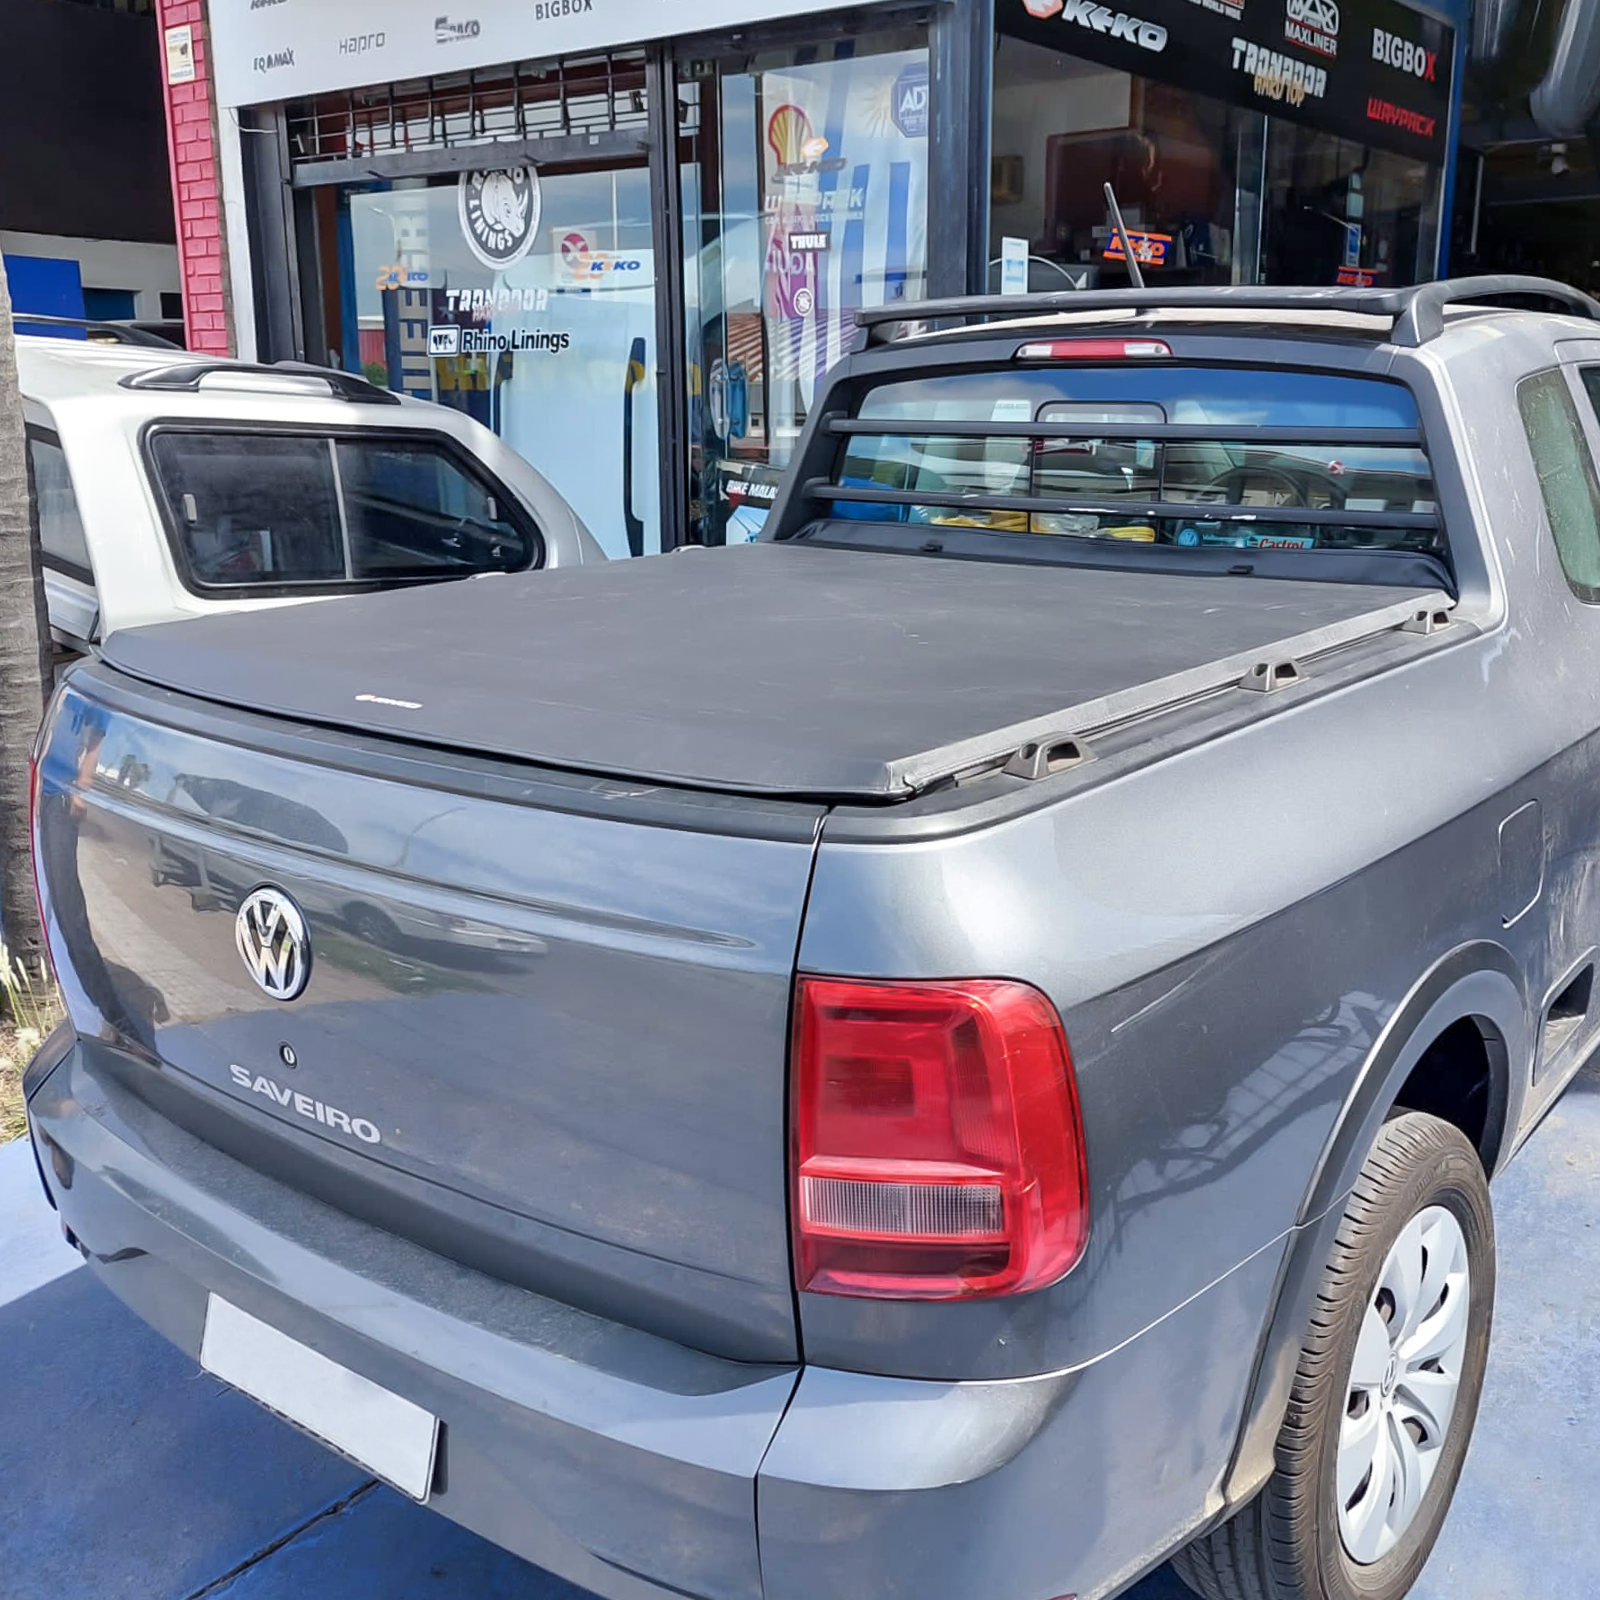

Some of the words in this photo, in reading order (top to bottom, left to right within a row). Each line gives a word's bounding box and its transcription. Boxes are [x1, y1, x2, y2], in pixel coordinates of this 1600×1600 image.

[535, 0, 593, 20] BIGBOX
[1284, 20, 1338, 56] MAXLINER
[1372, 27, 1437, 83] BIGBOX
[468, 199, 514, 251] LININGS
[789, 233, 827, 249] THULE
[462, 330, 506, 352] Rhino
[511, 329, 570, 354] Linings
[229, 1064, 382, 1144] SAVEIRO
